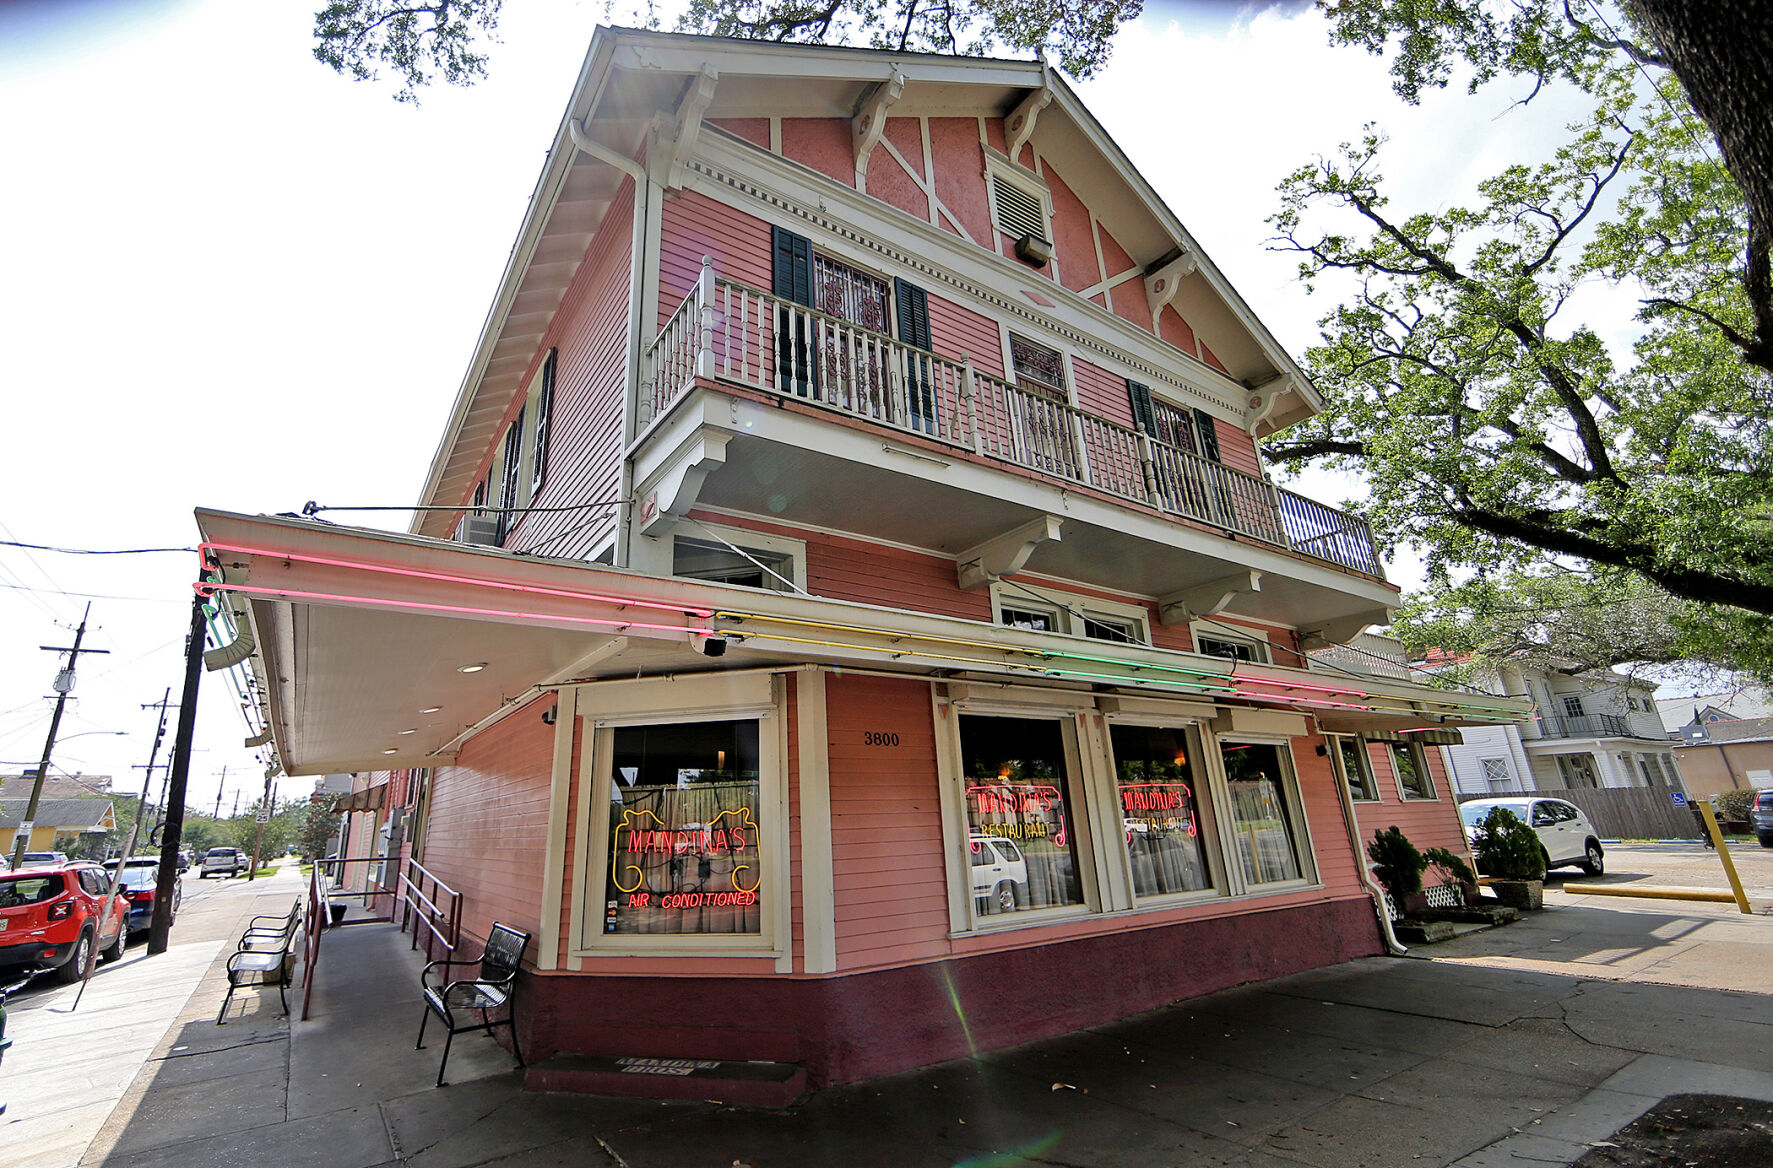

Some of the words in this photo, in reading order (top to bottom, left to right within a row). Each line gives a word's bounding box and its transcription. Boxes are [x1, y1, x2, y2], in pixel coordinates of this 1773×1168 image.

[864, 731, 900, 747] 3800
[977, 792, 1052, 814] MANDINA'S
[1123, 791, 1184, 810] MANDINA'S
[981, 822, 1050, 840] RESTAURANT
[1126, 816, 1183, 831] TAURANT
[628, 827, 746, 854] MANDINA'S
[628, 893, 650, 908] AIR
[661, 892, 756, 909] CONDITIONED
